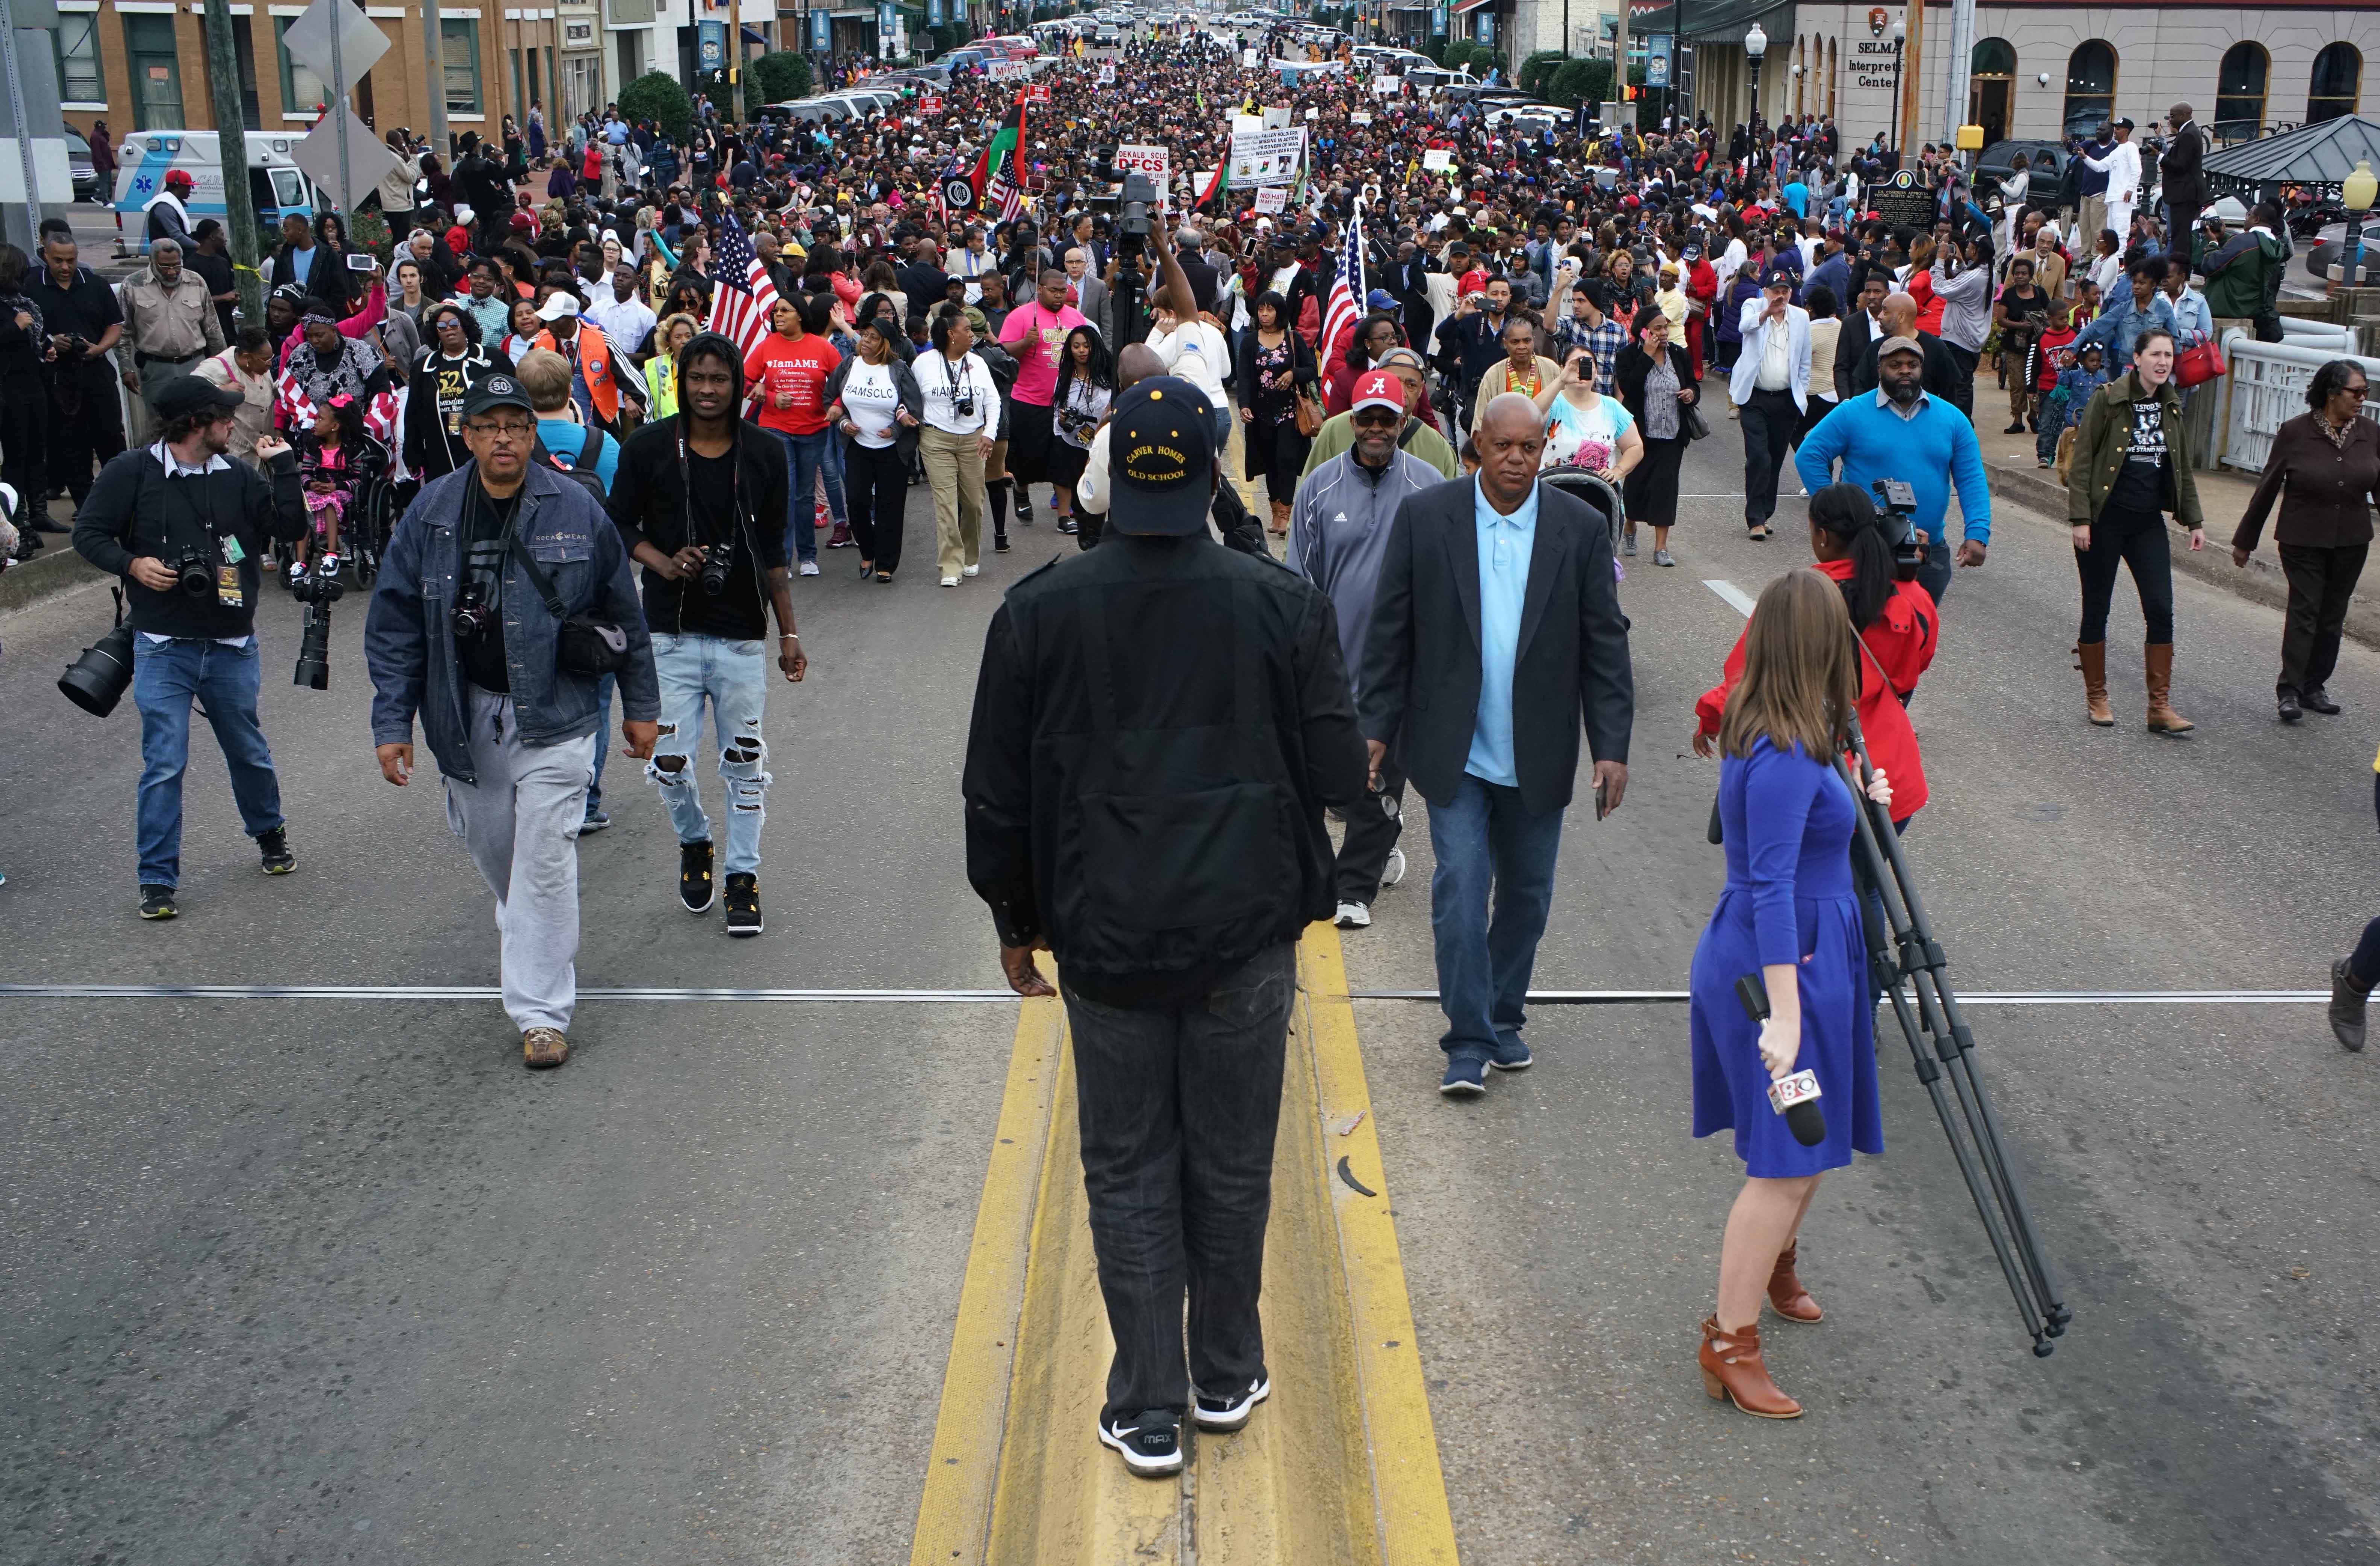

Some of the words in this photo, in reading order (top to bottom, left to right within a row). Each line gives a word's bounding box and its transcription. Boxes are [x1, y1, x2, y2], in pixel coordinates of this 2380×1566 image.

[995, 65, 1023, 77] MUST
[197, 175, 223, 185] CAR
[1042, 328, 1072, 343] SELM
[767, 359, 818, 368] #IamAME
[493, 381, 508, 391] 50
[845, 384, 893, 399] #IAMSCLC
[932, 386, 980, 397] #IAMSCLC
[1366, 377, 1385, 394] A
[1127, 445, 1154, 464] CARVER
[1157, 445, 1186, 464] HOMES
[1128, 469, 1146, 479] OLD
[1148, 470, 1186, 481] SCHOOL
[1782, 1081, 1796, 1100] 8
[1144, 1434, 1172, 1444] MAX
